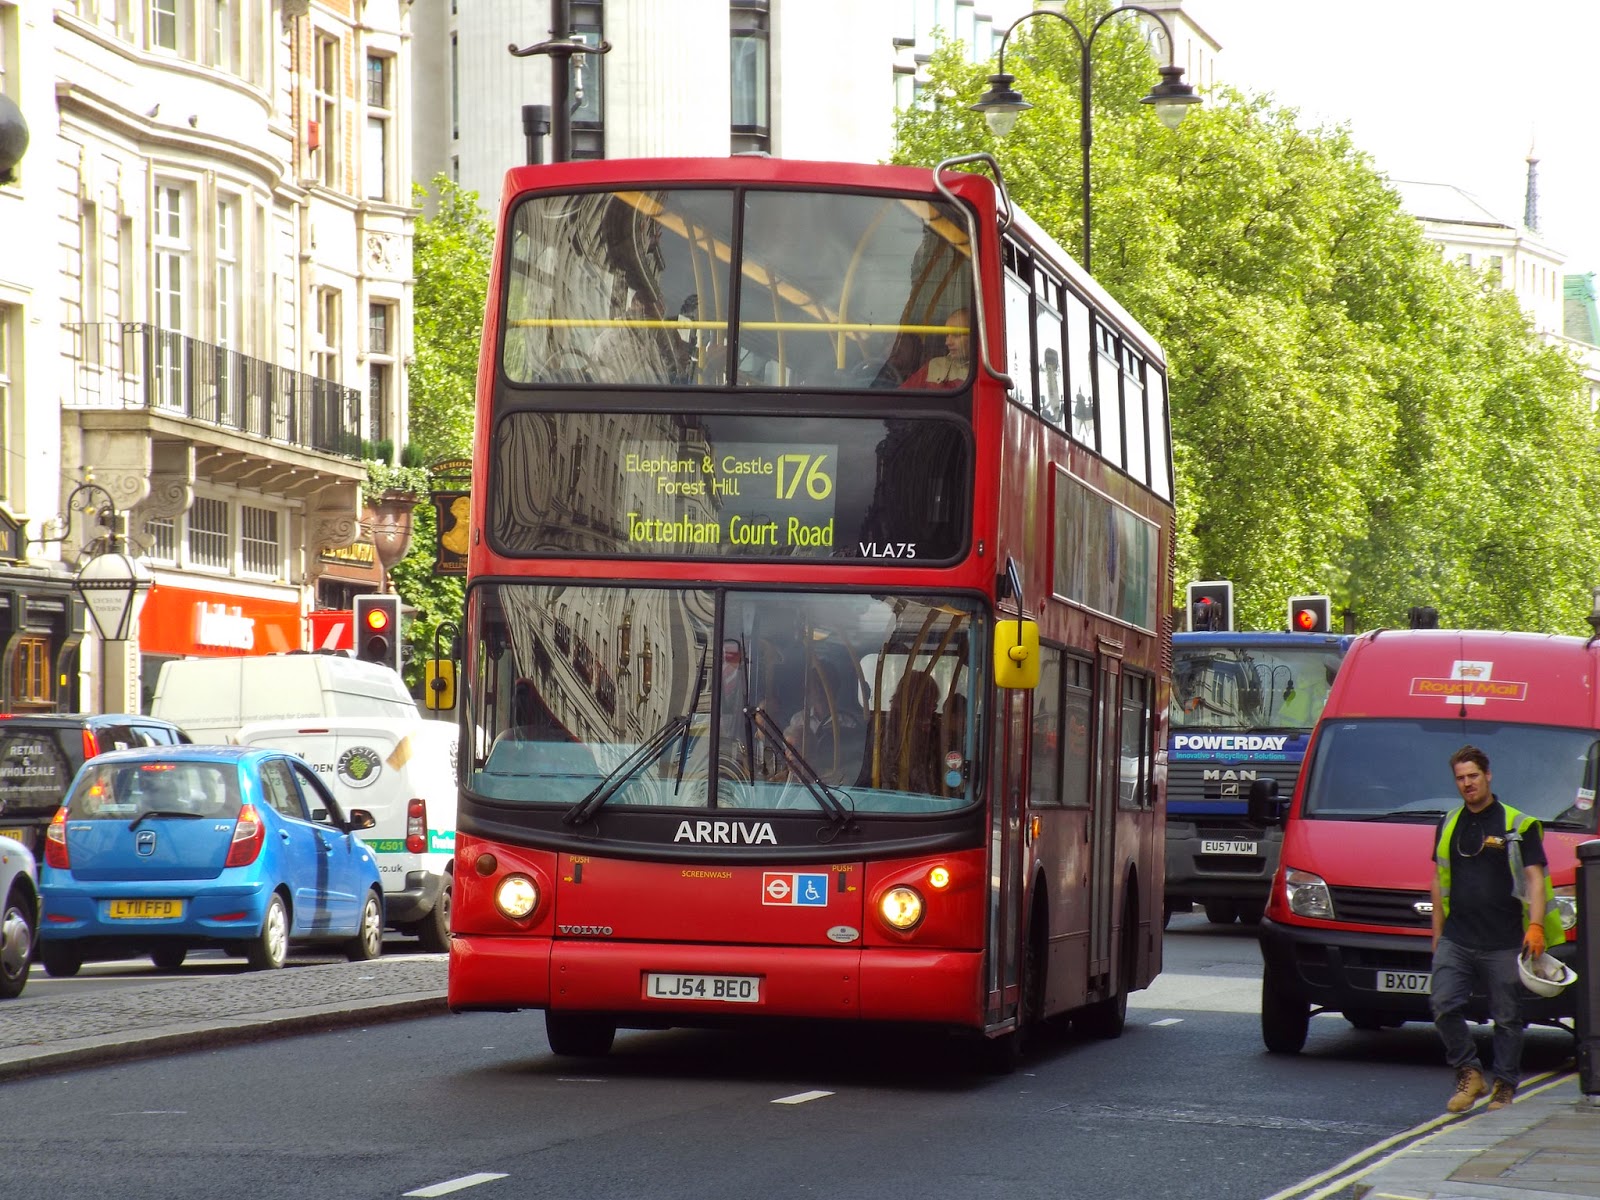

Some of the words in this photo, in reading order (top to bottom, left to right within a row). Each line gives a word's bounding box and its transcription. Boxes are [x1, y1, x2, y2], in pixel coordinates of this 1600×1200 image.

[626, 454, 695, 477] Elephant
[702, 456, 714, 474] &
[722, 456, 773, 474] Castle
[776, 454, 833, 500] 176
[657, 477, 706, 495] Forest
[712, 478, 740, 496] Hill
[627, 512, 720, 543] Tottenham
[729, 515, 778, 545] Court
[788, 515, 834, 547] Road
[859, 542, 916, 558] VLA75
[1420, 680, 1473, 695] Royal
[1476, 682, 1519, 695] Mail
[10, 745, 43, 755] RETAIL
[1174, 735, 1287, 751] POWERDAY
[22, 756, 30, 766] &
[337, 748, 379, 772] MAJESTIC
[1215, 752, 1248, 760] Recycling
[1203, 769, 1256, 781] MAN
[673, 820, 778, 845] ARRIVA
[1205, 842, 1231, 851] EU57
[1234, 843, 1253, 852] VUM
[681, 870, 732, 879] SCREENWASH
[145, 901, 172, 914] FFD
[558, 925, 613, 935] VOLVO
[655, 977, 706, 997] LJ54
[713, 979, 752, 998] BEO
[1385, 973, 1428, 990] BX07
